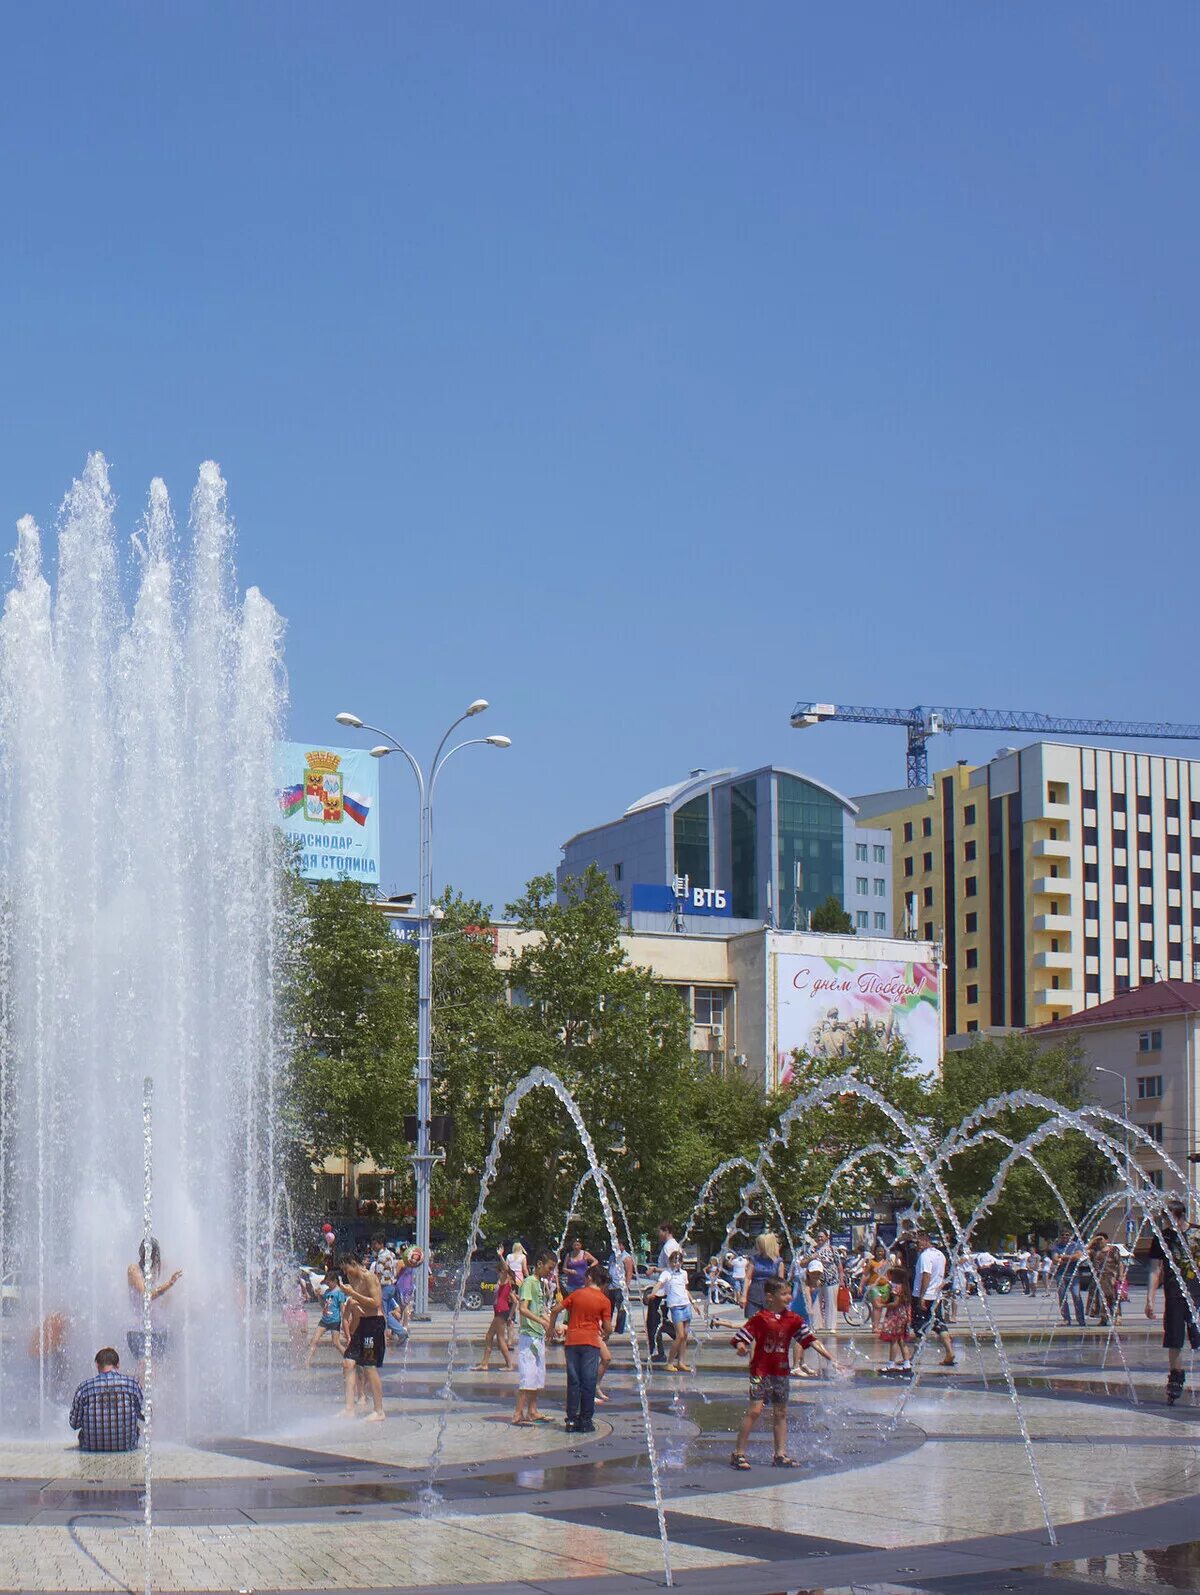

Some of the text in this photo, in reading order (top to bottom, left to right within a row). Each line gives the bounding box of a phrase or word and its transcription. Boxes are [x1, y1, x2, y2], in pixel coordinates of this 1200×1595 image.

[321, 855, 376, 873] СТОЛИЦА
[693, 887, 727, 909] ВТБ
[793, 968, 810, 989] С
[857, 972, 926, 1003] Победы!
